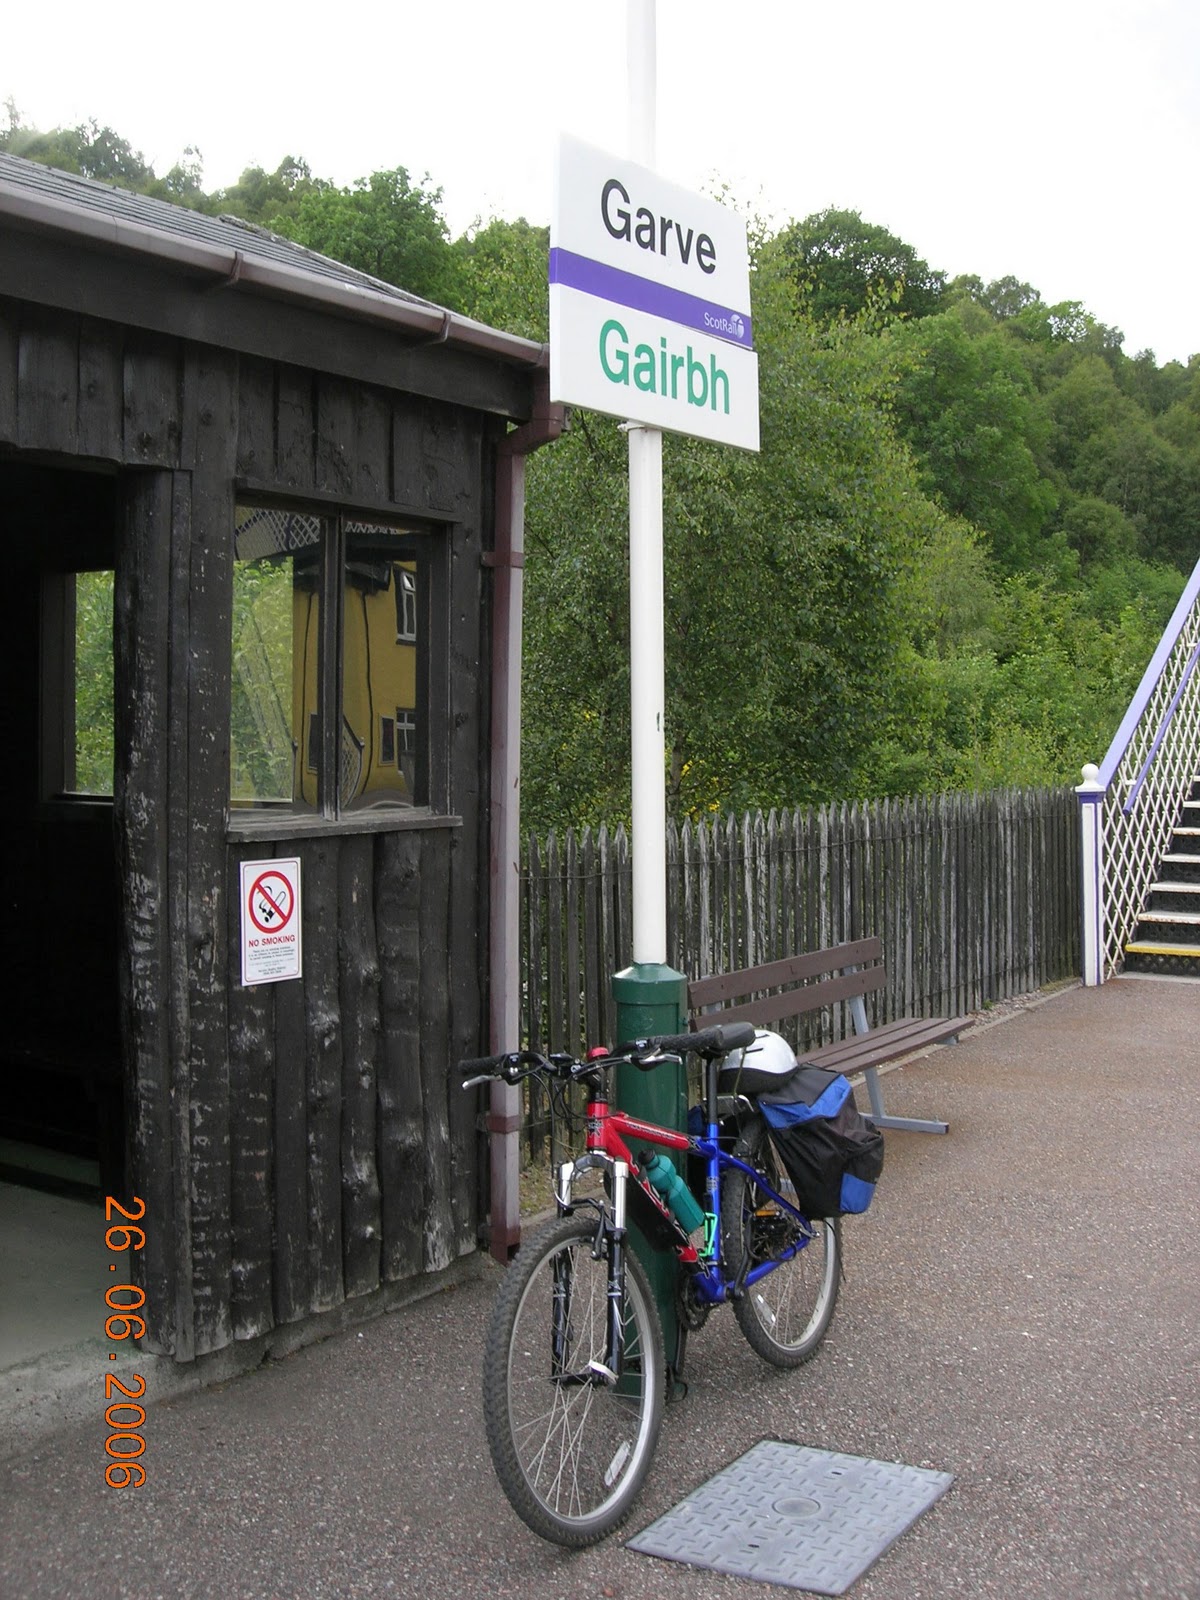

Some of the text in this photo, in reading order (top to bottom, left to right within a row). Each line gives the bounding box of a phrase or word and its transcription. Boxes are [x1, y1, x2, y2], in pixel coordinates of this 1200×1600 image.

[601, 178, 717, 274] Garve
[704, 312, 738, 335] ScotRail
[599, 319, 730, 415] Gairbh
[248, 935, 295, 948] NO SMOKING
